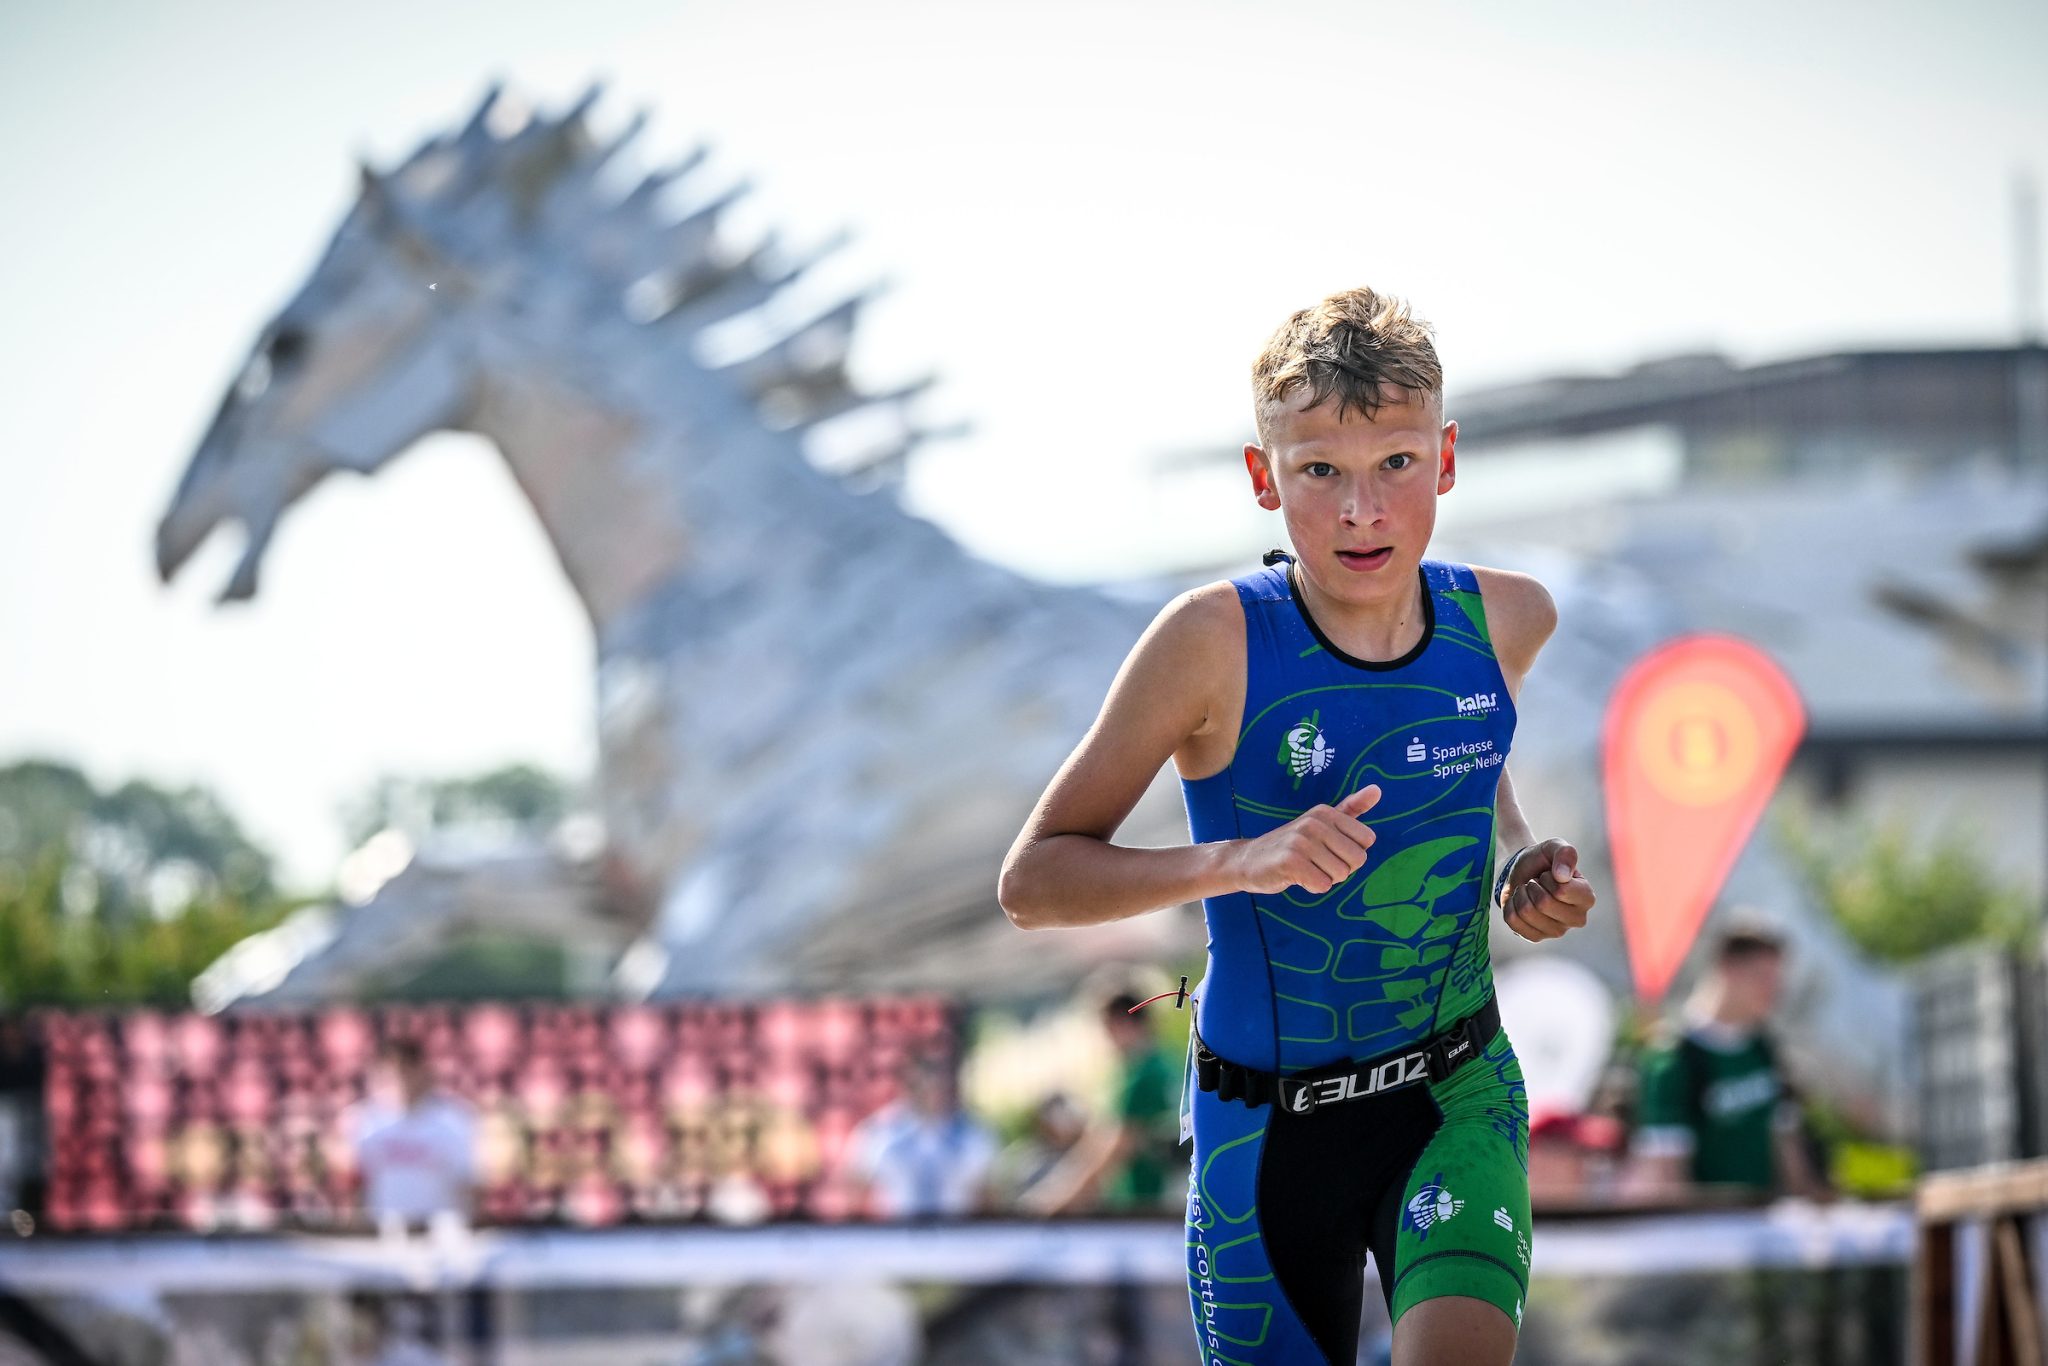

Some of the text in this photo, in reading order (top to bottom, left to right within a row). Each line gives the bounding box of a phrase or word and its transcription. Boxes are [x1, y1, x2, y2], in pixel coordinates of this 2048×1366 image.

[1455, 692, 1497, 713] kalas
[1432, 740, 1493, 761] Sparkasse
[1433, 752, 1503, 779] Spree-Neiße
